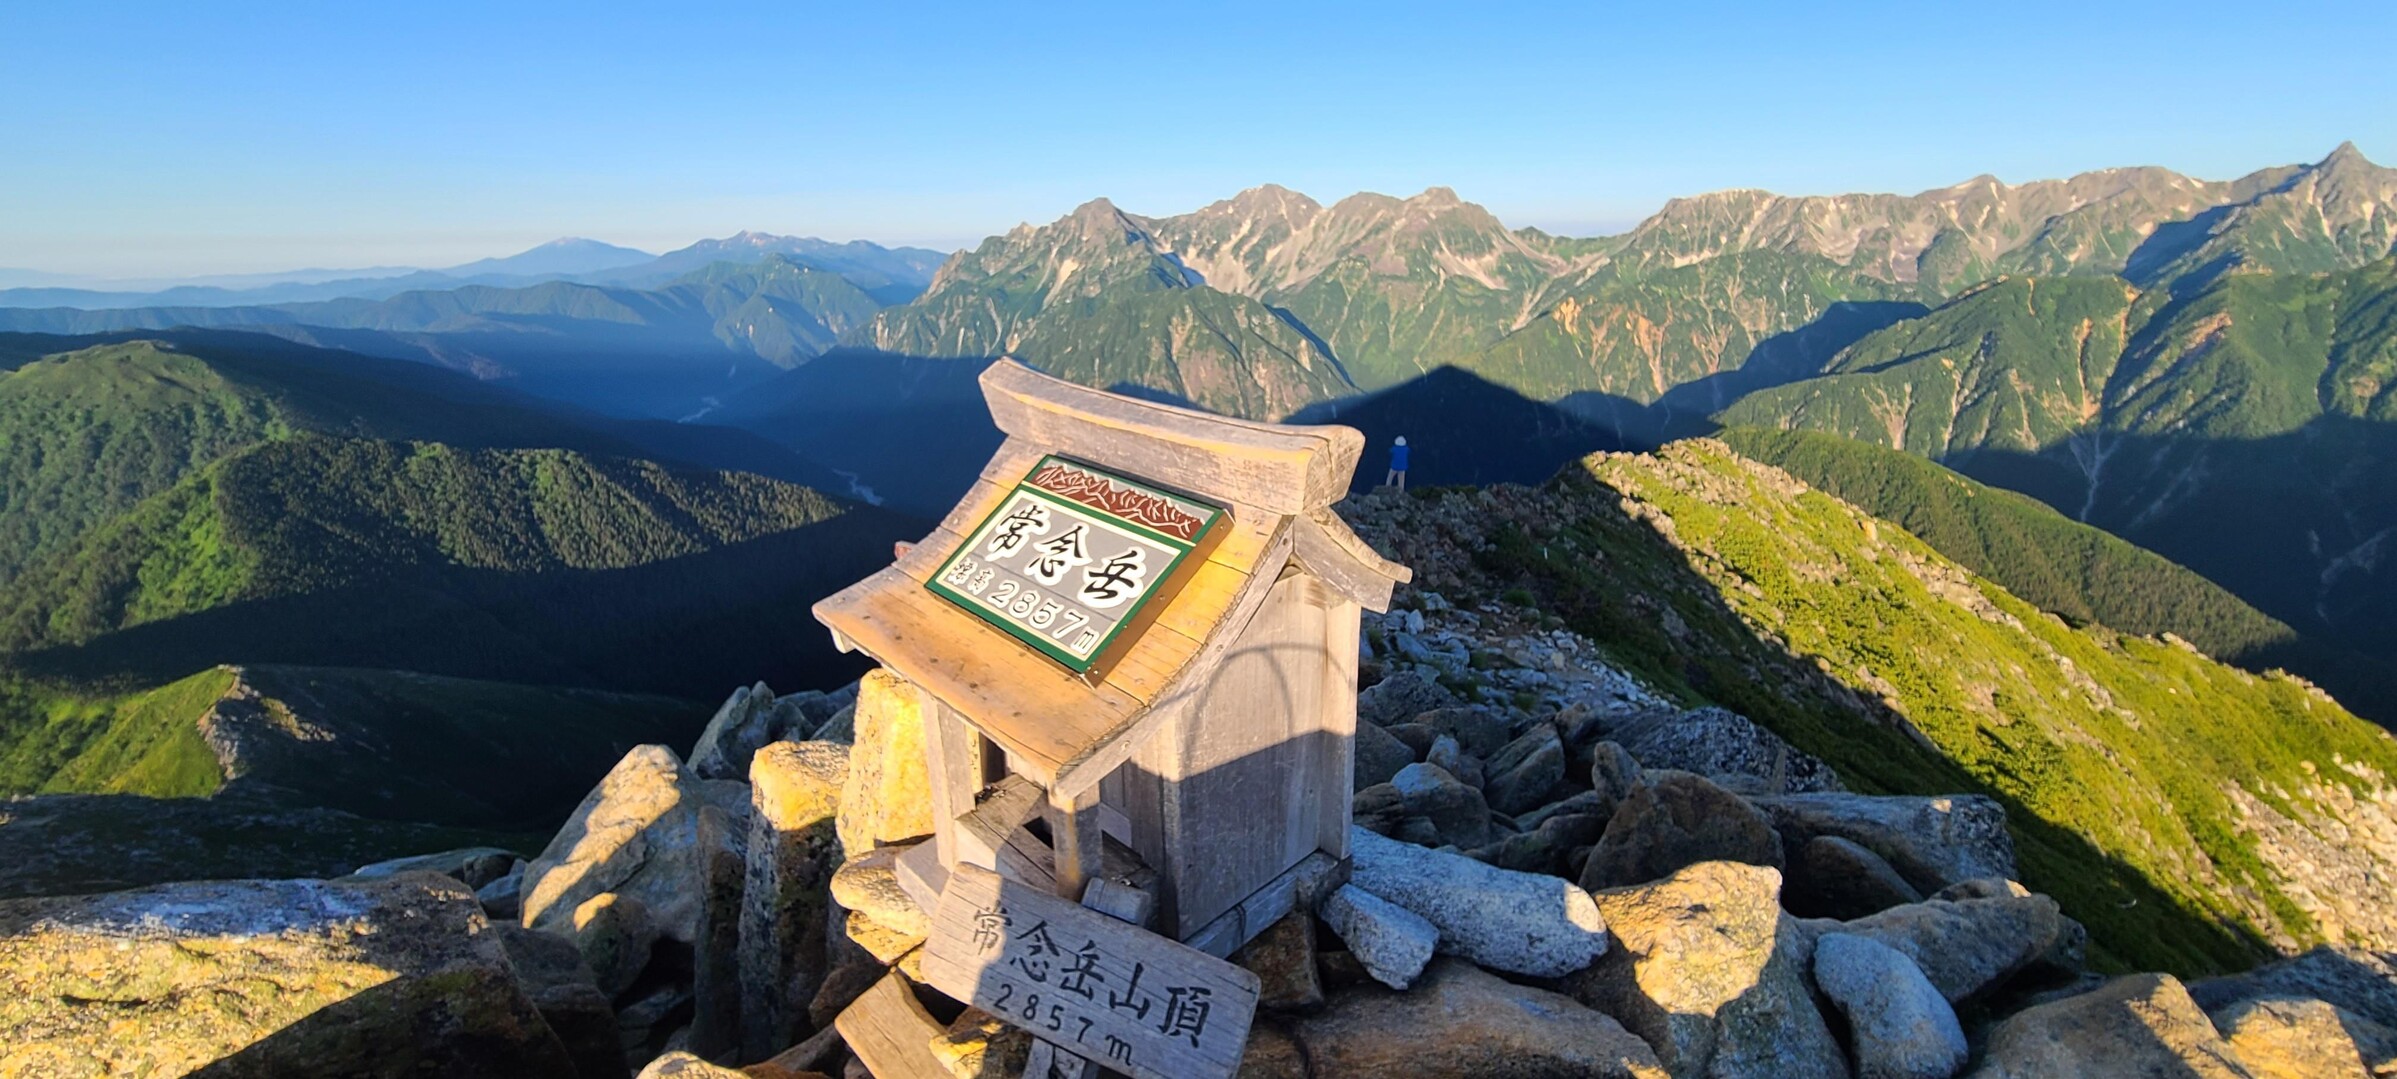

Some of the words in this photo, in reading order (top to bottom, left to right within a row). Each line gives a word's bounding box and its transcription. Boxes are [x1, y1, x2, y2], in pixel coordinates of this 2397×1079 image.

[991, 503, 1139, 601] 常念岳
[989, 582, 1097, 651] 2857m
[973, 901, 1212, 1048] 常念岳山頂
